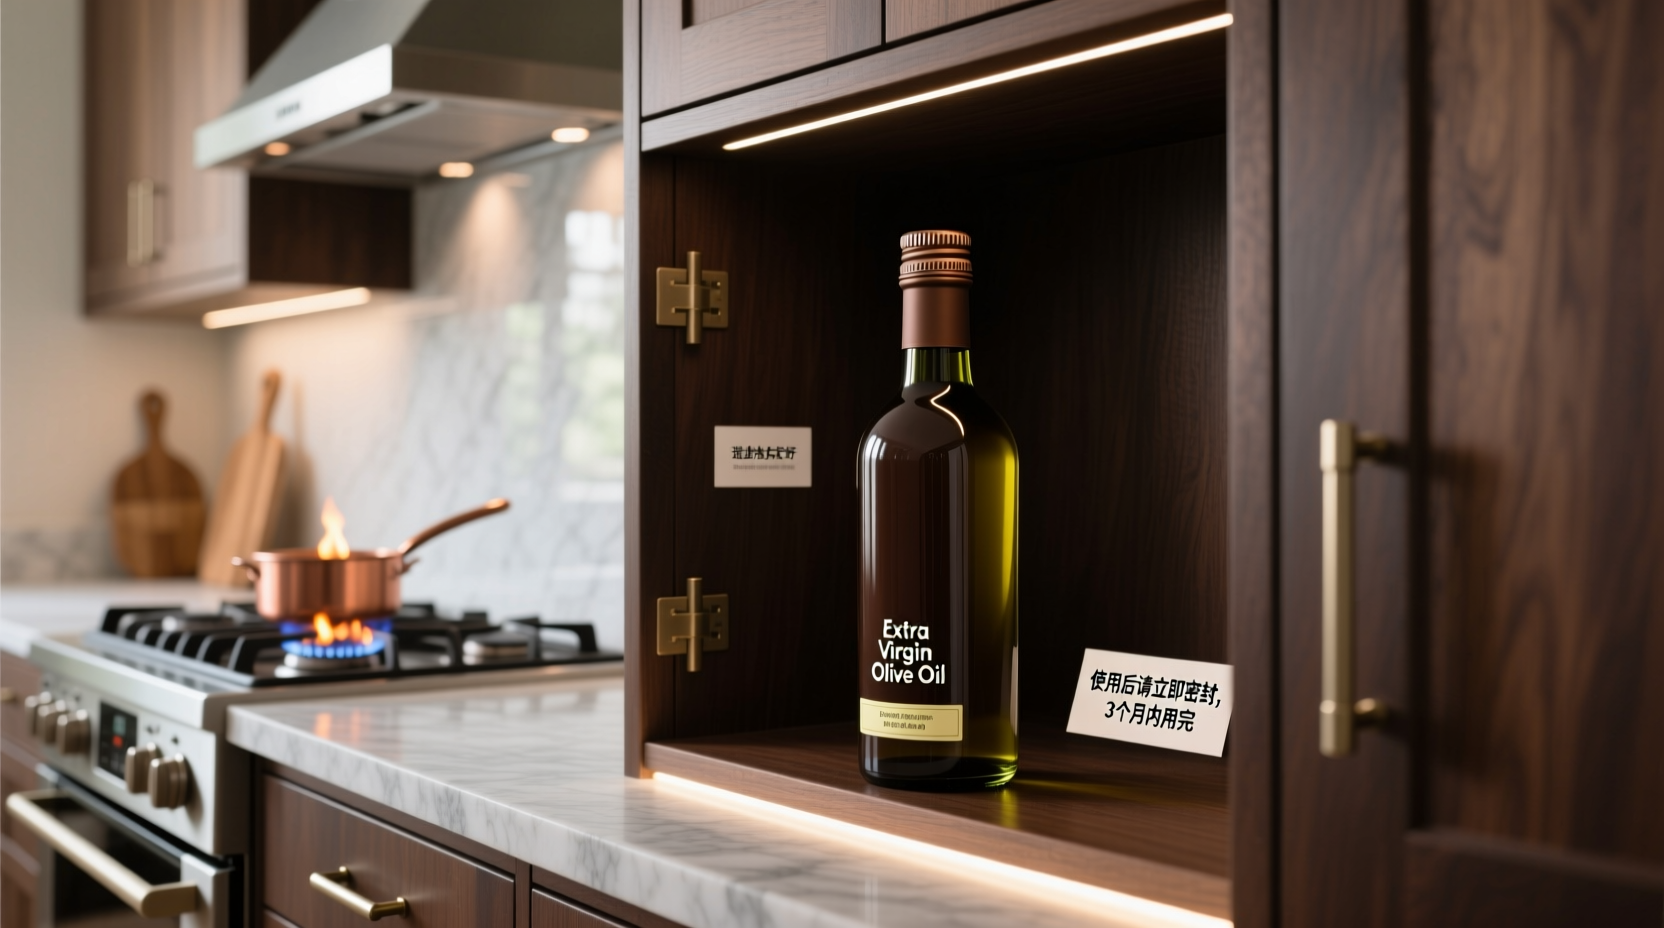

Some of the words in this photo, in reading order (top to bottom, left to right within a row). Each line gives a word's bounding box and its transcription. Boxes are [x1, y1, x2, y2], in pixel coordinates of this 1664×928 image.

[883, 619, 930, 640] Extra
[878, 639, 932, 666] Virgin
[871, 661, 914, 684] Olive
[918, 664, 946, 684] Oil
[1104, 700, 1196, 732] 3个月内用完
